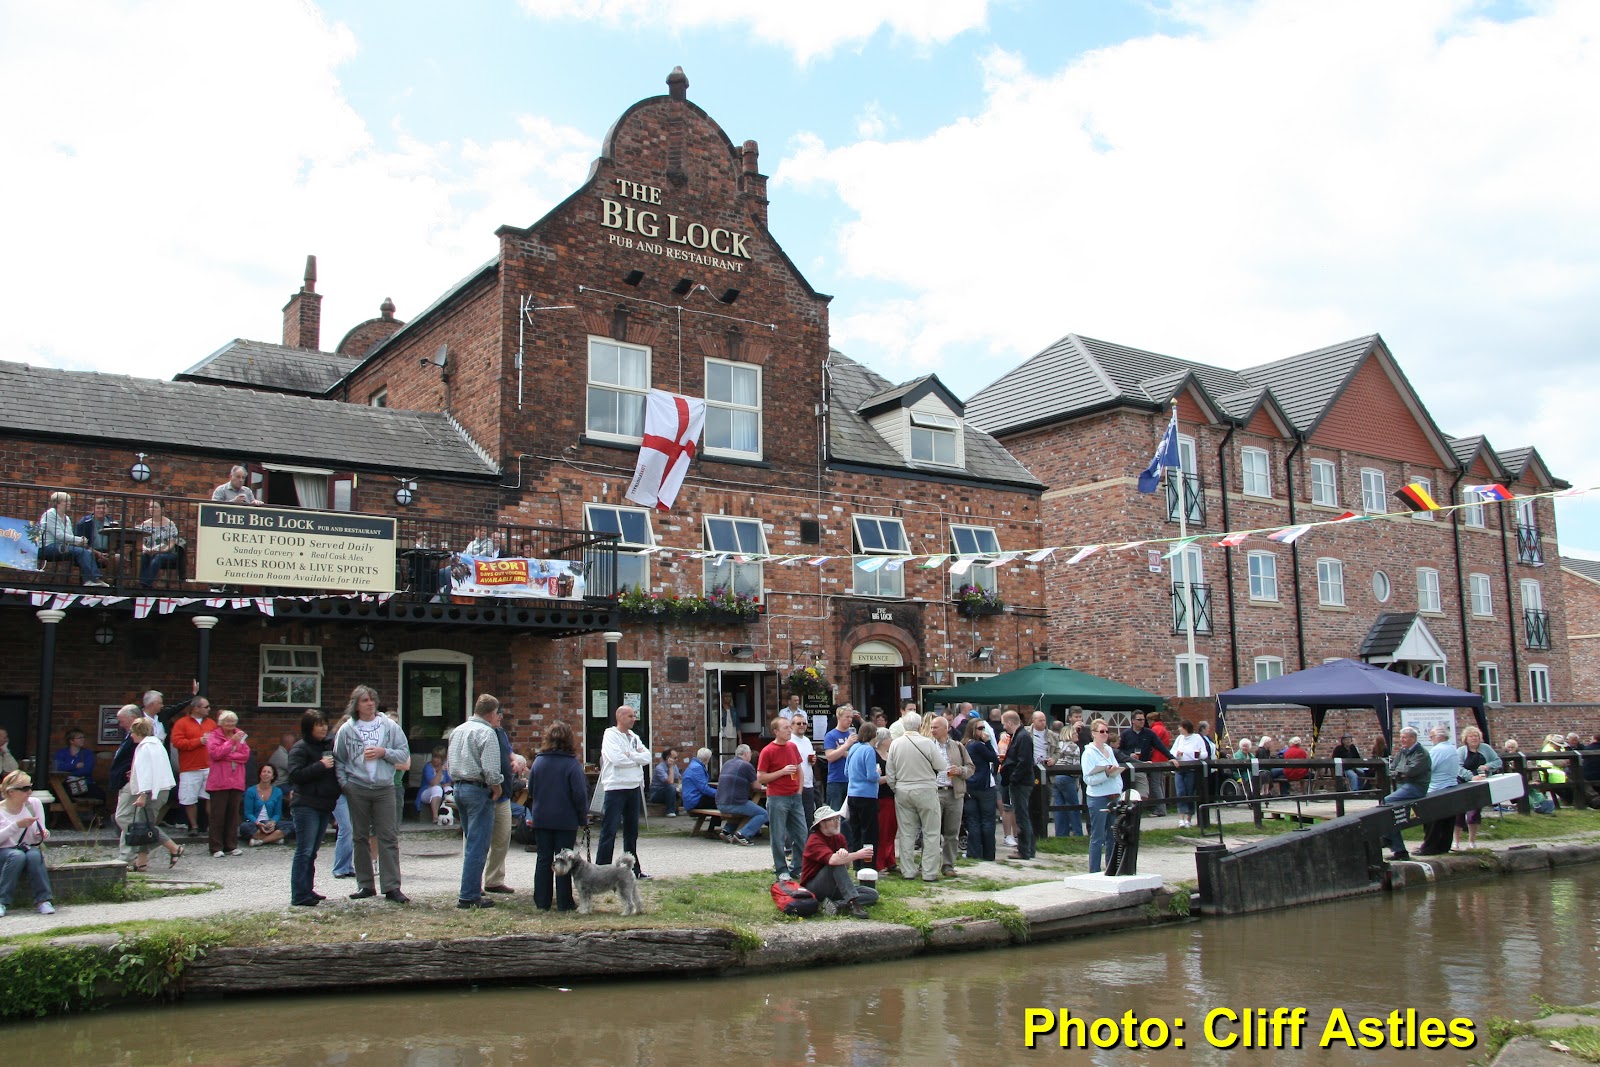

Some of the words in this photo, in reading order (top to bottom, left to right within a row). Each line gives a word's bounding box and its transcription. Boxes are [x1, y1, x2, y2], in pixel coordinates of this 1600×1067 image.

[616, 178, 662, 206] THE
[600, 198, 660, 238] BIG
[667, 213, 752, 259] LOCK
[608, 234, 633, 249] PUB
[636, 240, 663, 256] AND
[666, 247, 743, 273] RESTAURANT
[215, 511, 245, 525] THE
[248, 513, 274, 528] BIG
[278, 516, 315, 530] LOCK
[344, 527, 382, 535] RESTAURANT
[222, 532, 266, 544] GREAT
[269, 534, 305, 547] FOOD
[309, 539, 345, 550] Served
[347, 542, 375, 553] Daily
[233, 546, 263, 557] Sunday
[264, 547, 295, 558] Carvery
[311, 551, 328, 559] Real
[328, 552, 347, 561] Cask
[348, 553, 364, 562] Ales
[216, 557, 258, 568] GAMES
[261, 560, 296, 570] ROOM
[299, 562, 306, 571] &
[309, 562, 334, 573] LIVE
[337, 565, 379, 575] SPORTS
[478, 561, 489, 571] 2
[489, 561, 519, 571] FOR
[519, 561, 526, 570] 1
[224, 569, 264, 579] Function
[266, 572, 291, 580] Room
[293, 573, 336, 583] Available
[336, 575, 350, 585] for
[352, 577, 371, 585] Hire
[858, 654, 889, 662] ENTRANCE
